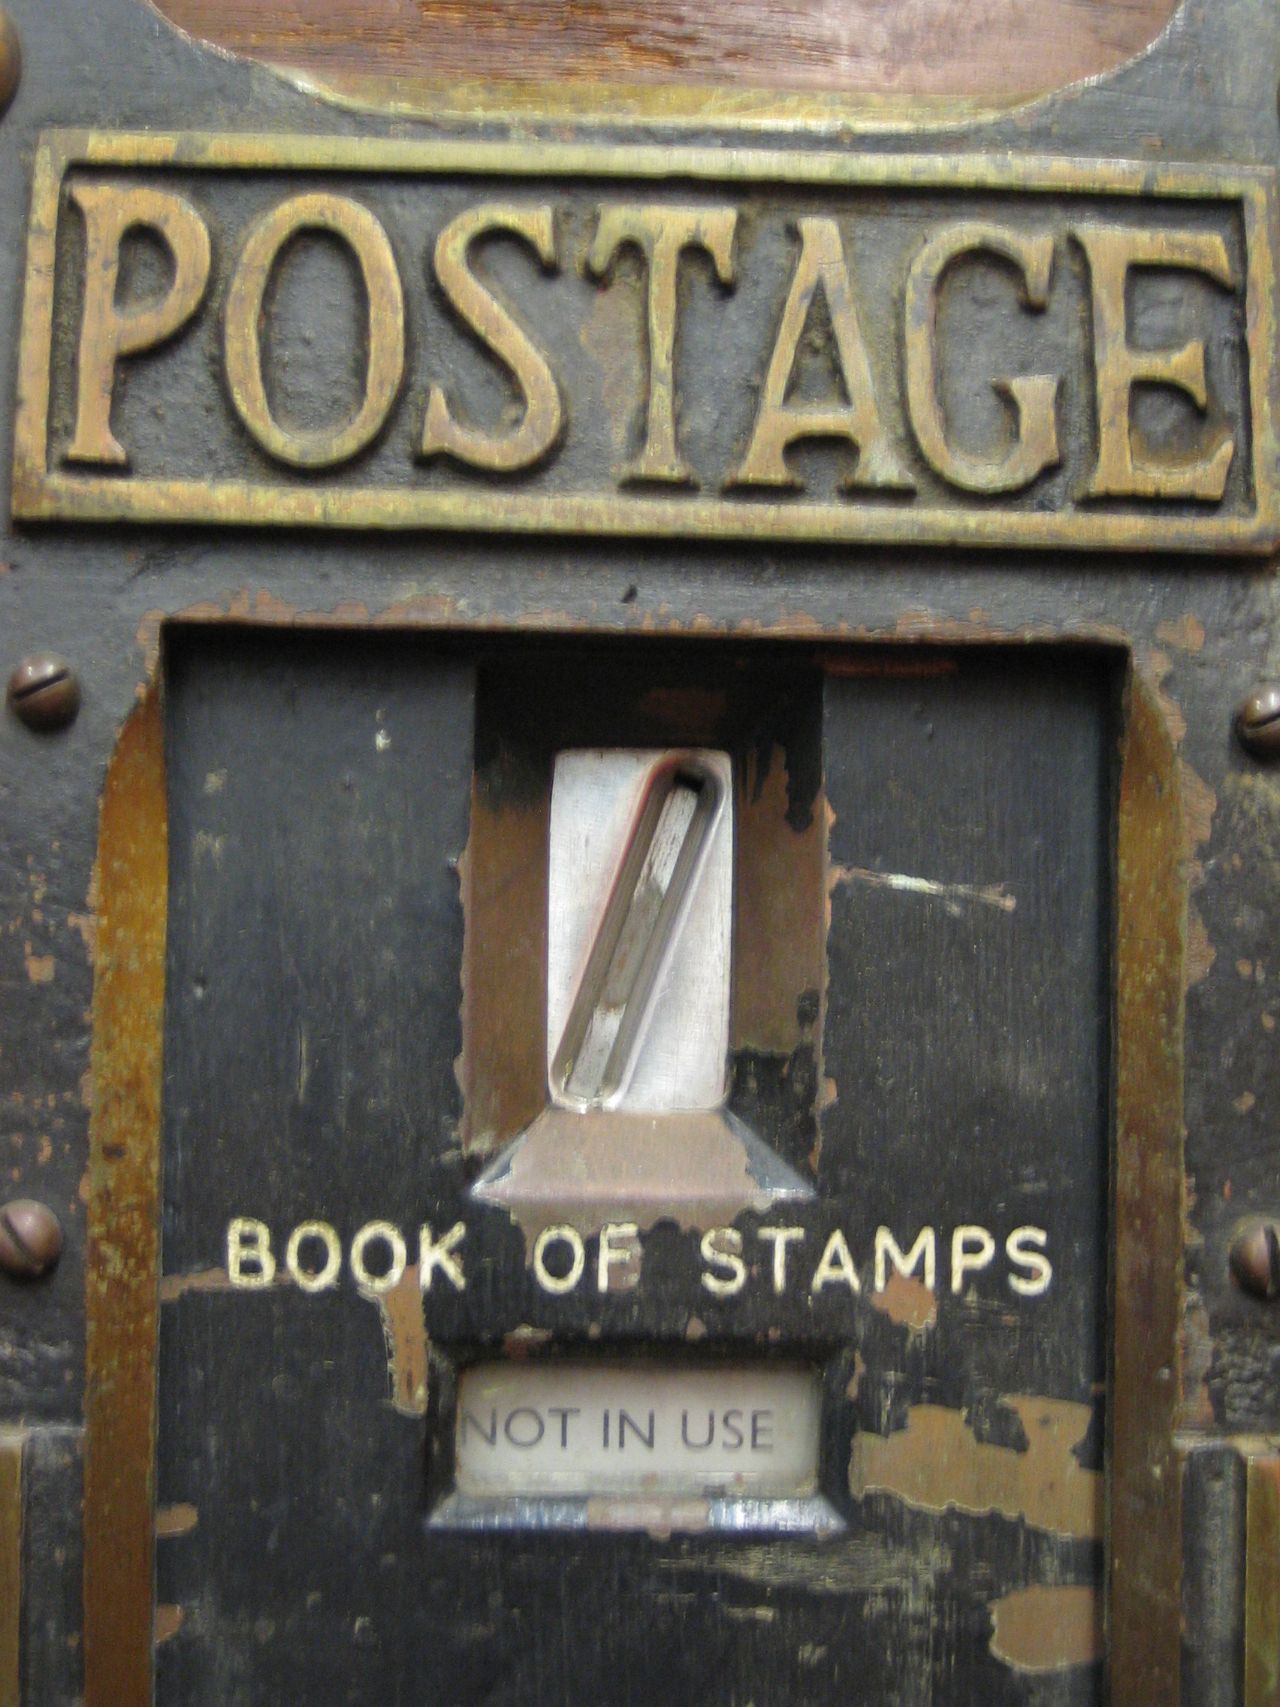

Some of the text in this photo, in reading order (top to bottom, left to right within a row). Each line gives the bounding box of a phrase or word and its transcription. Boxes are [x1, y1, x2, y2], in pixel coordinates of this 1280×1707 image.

[60, 184, 1238, 502] POSTAGE
[227, 1216, 1053, 1297] BOOK OF STAMPS
[462, 1407, 774, 1451] NOT IN USE
